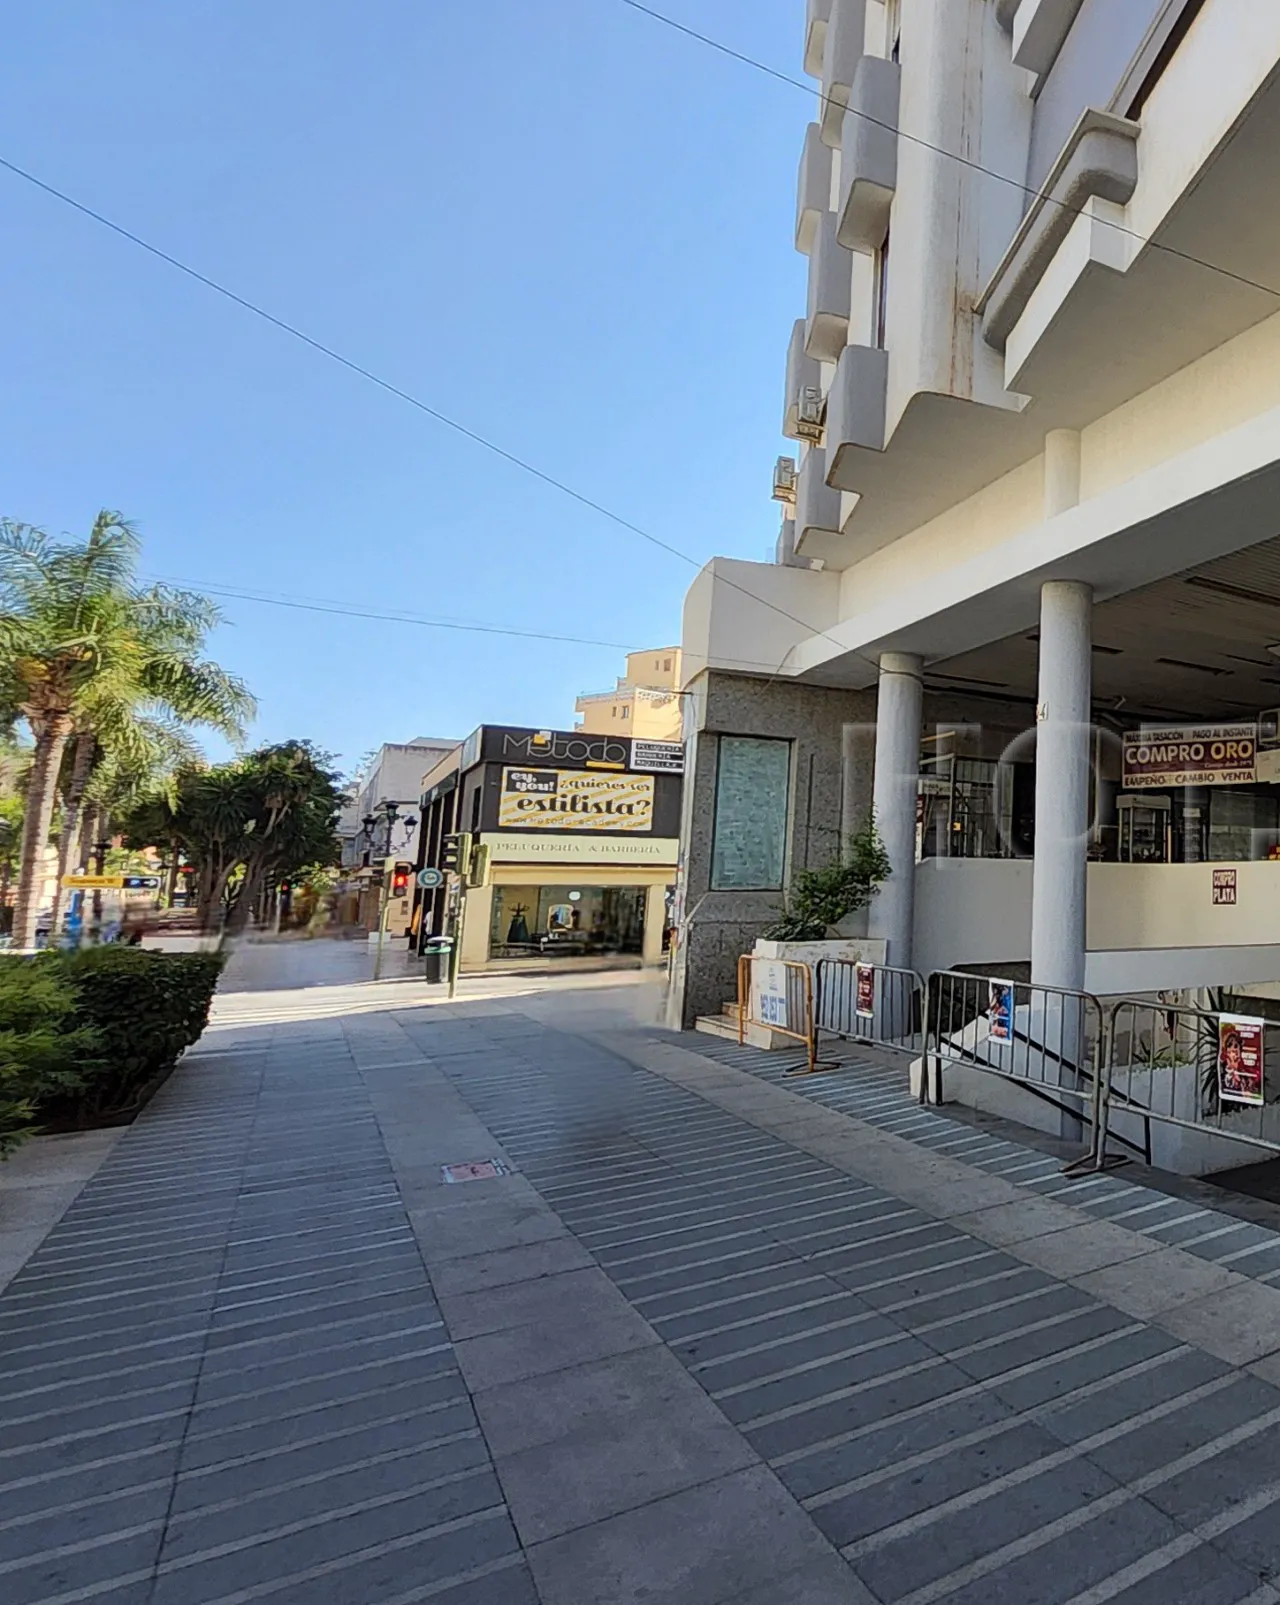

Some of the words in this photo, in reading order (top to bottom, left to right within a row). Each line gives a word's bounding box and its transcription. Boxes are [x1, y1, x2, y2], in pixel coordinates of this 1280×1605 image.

[1192, 729, 1211, 740] PAGO
[1125, 743, 1204, 765] COMPRO
[1210, 740, 1253, 761] ORO
[515, 781, 554, 792] you!
[1125, 774, 1165, 787] EMPEÑO
[1175, 772, 1215, 785] CAMBIO
[1221, 771, 1254, 782] VENTA
[517, 793, 651, 816] estilista?
[1213, 888, 1236, 903] PLATA
